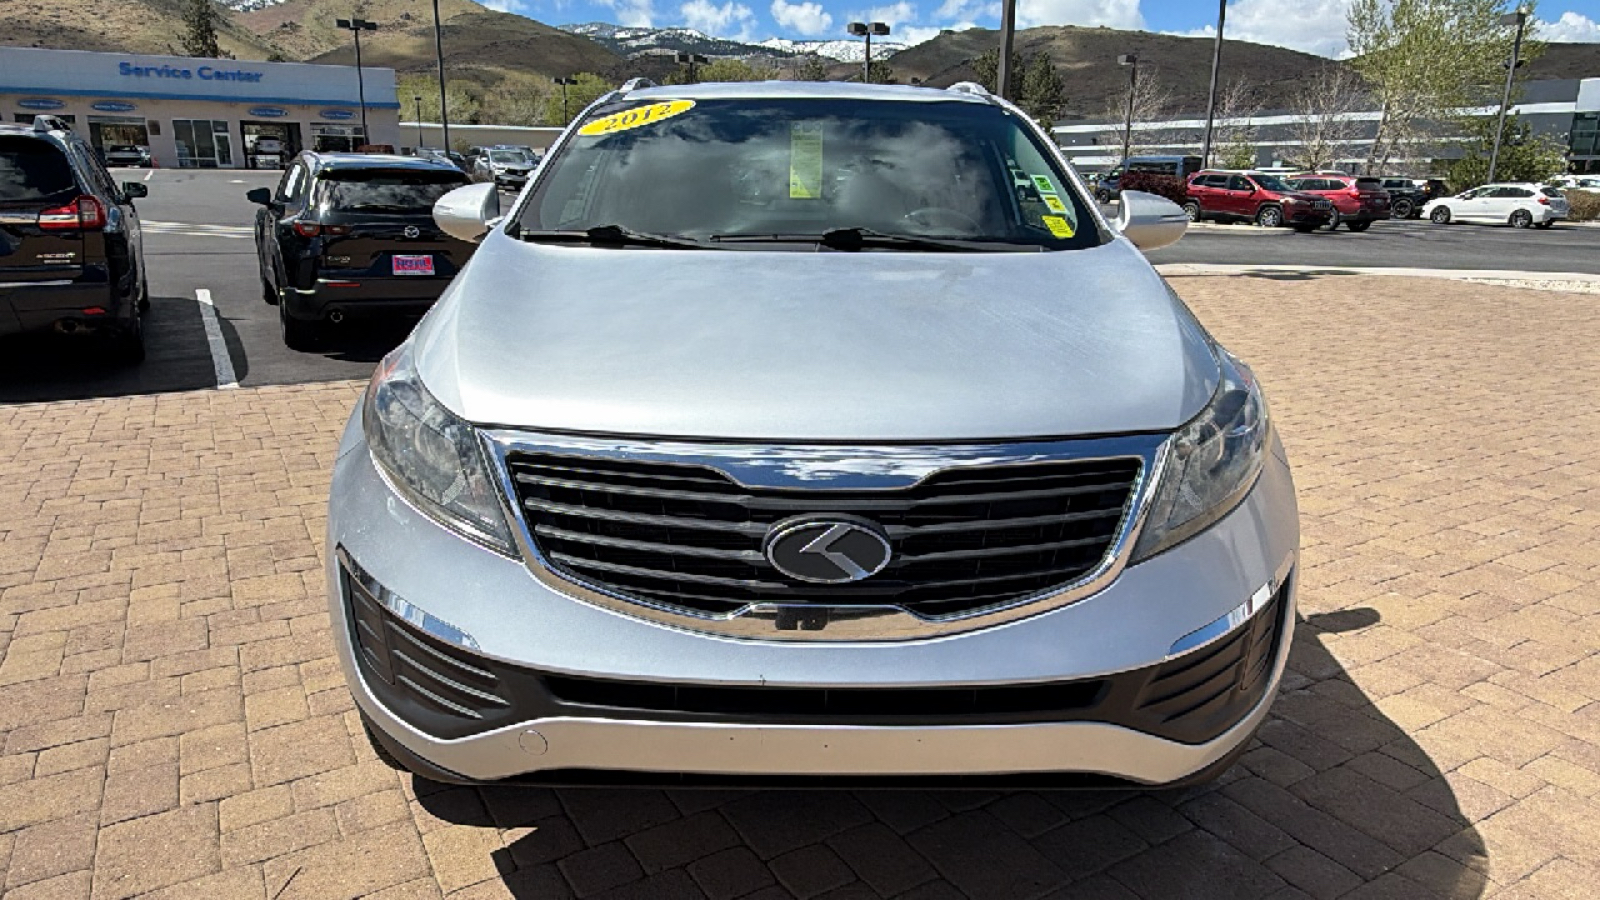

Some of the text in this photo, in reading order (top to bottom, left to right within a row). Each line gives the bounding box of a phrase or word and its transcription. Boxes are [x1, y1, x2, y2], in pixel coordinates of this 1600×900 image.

[119, 62, 263, 82] Service Center
[604, 104, 671, 131] 2012
